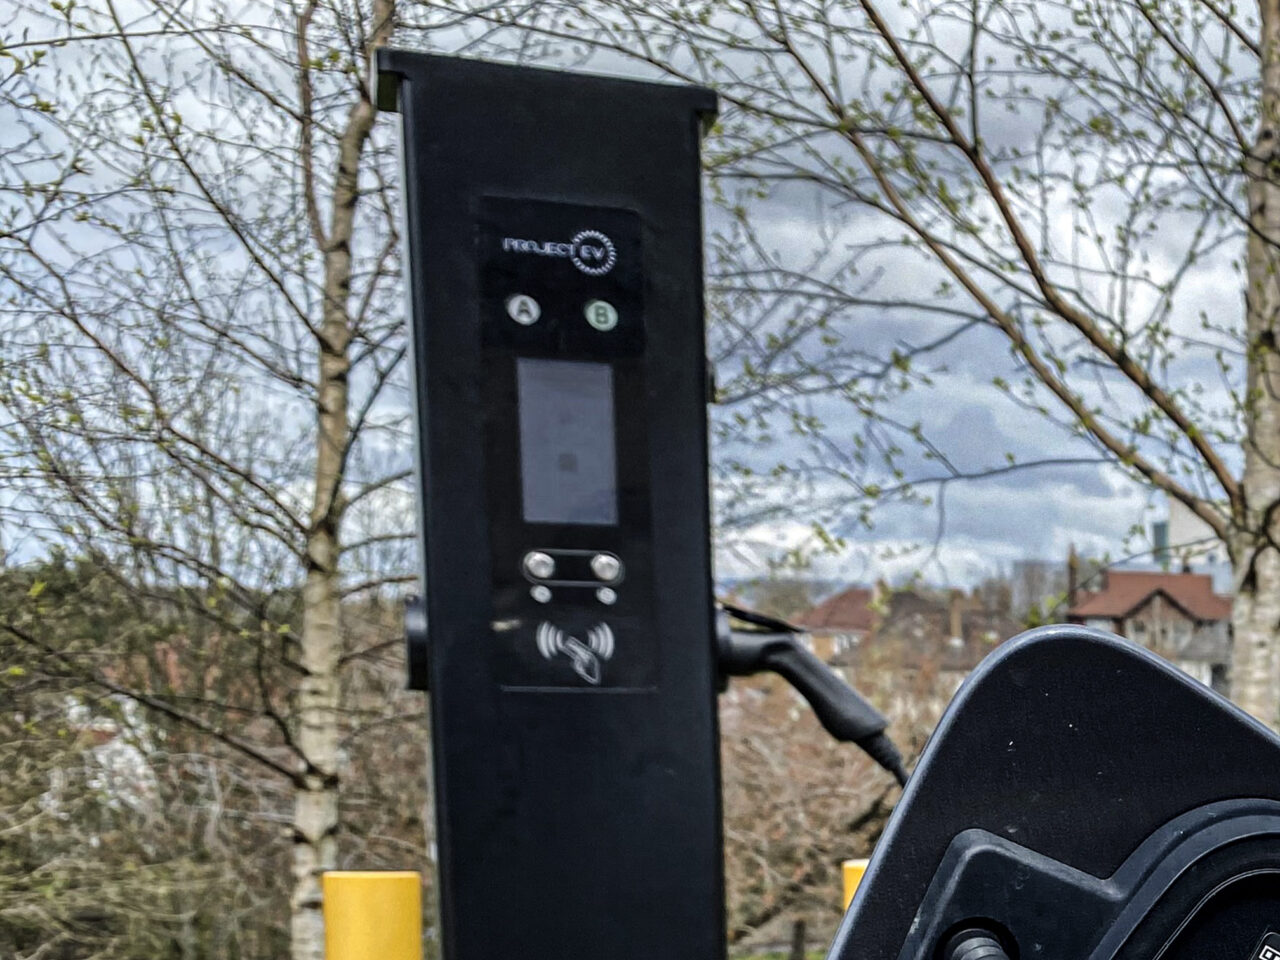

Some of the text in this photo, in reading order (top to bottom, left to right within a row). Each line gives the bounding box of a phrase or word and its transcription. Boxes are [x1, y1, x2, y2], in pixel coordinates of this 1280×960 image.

[504, 238, 604, 259] PROJECT EV
[517, 300, 531, 318] A
[595, 305, 609, 325] B
